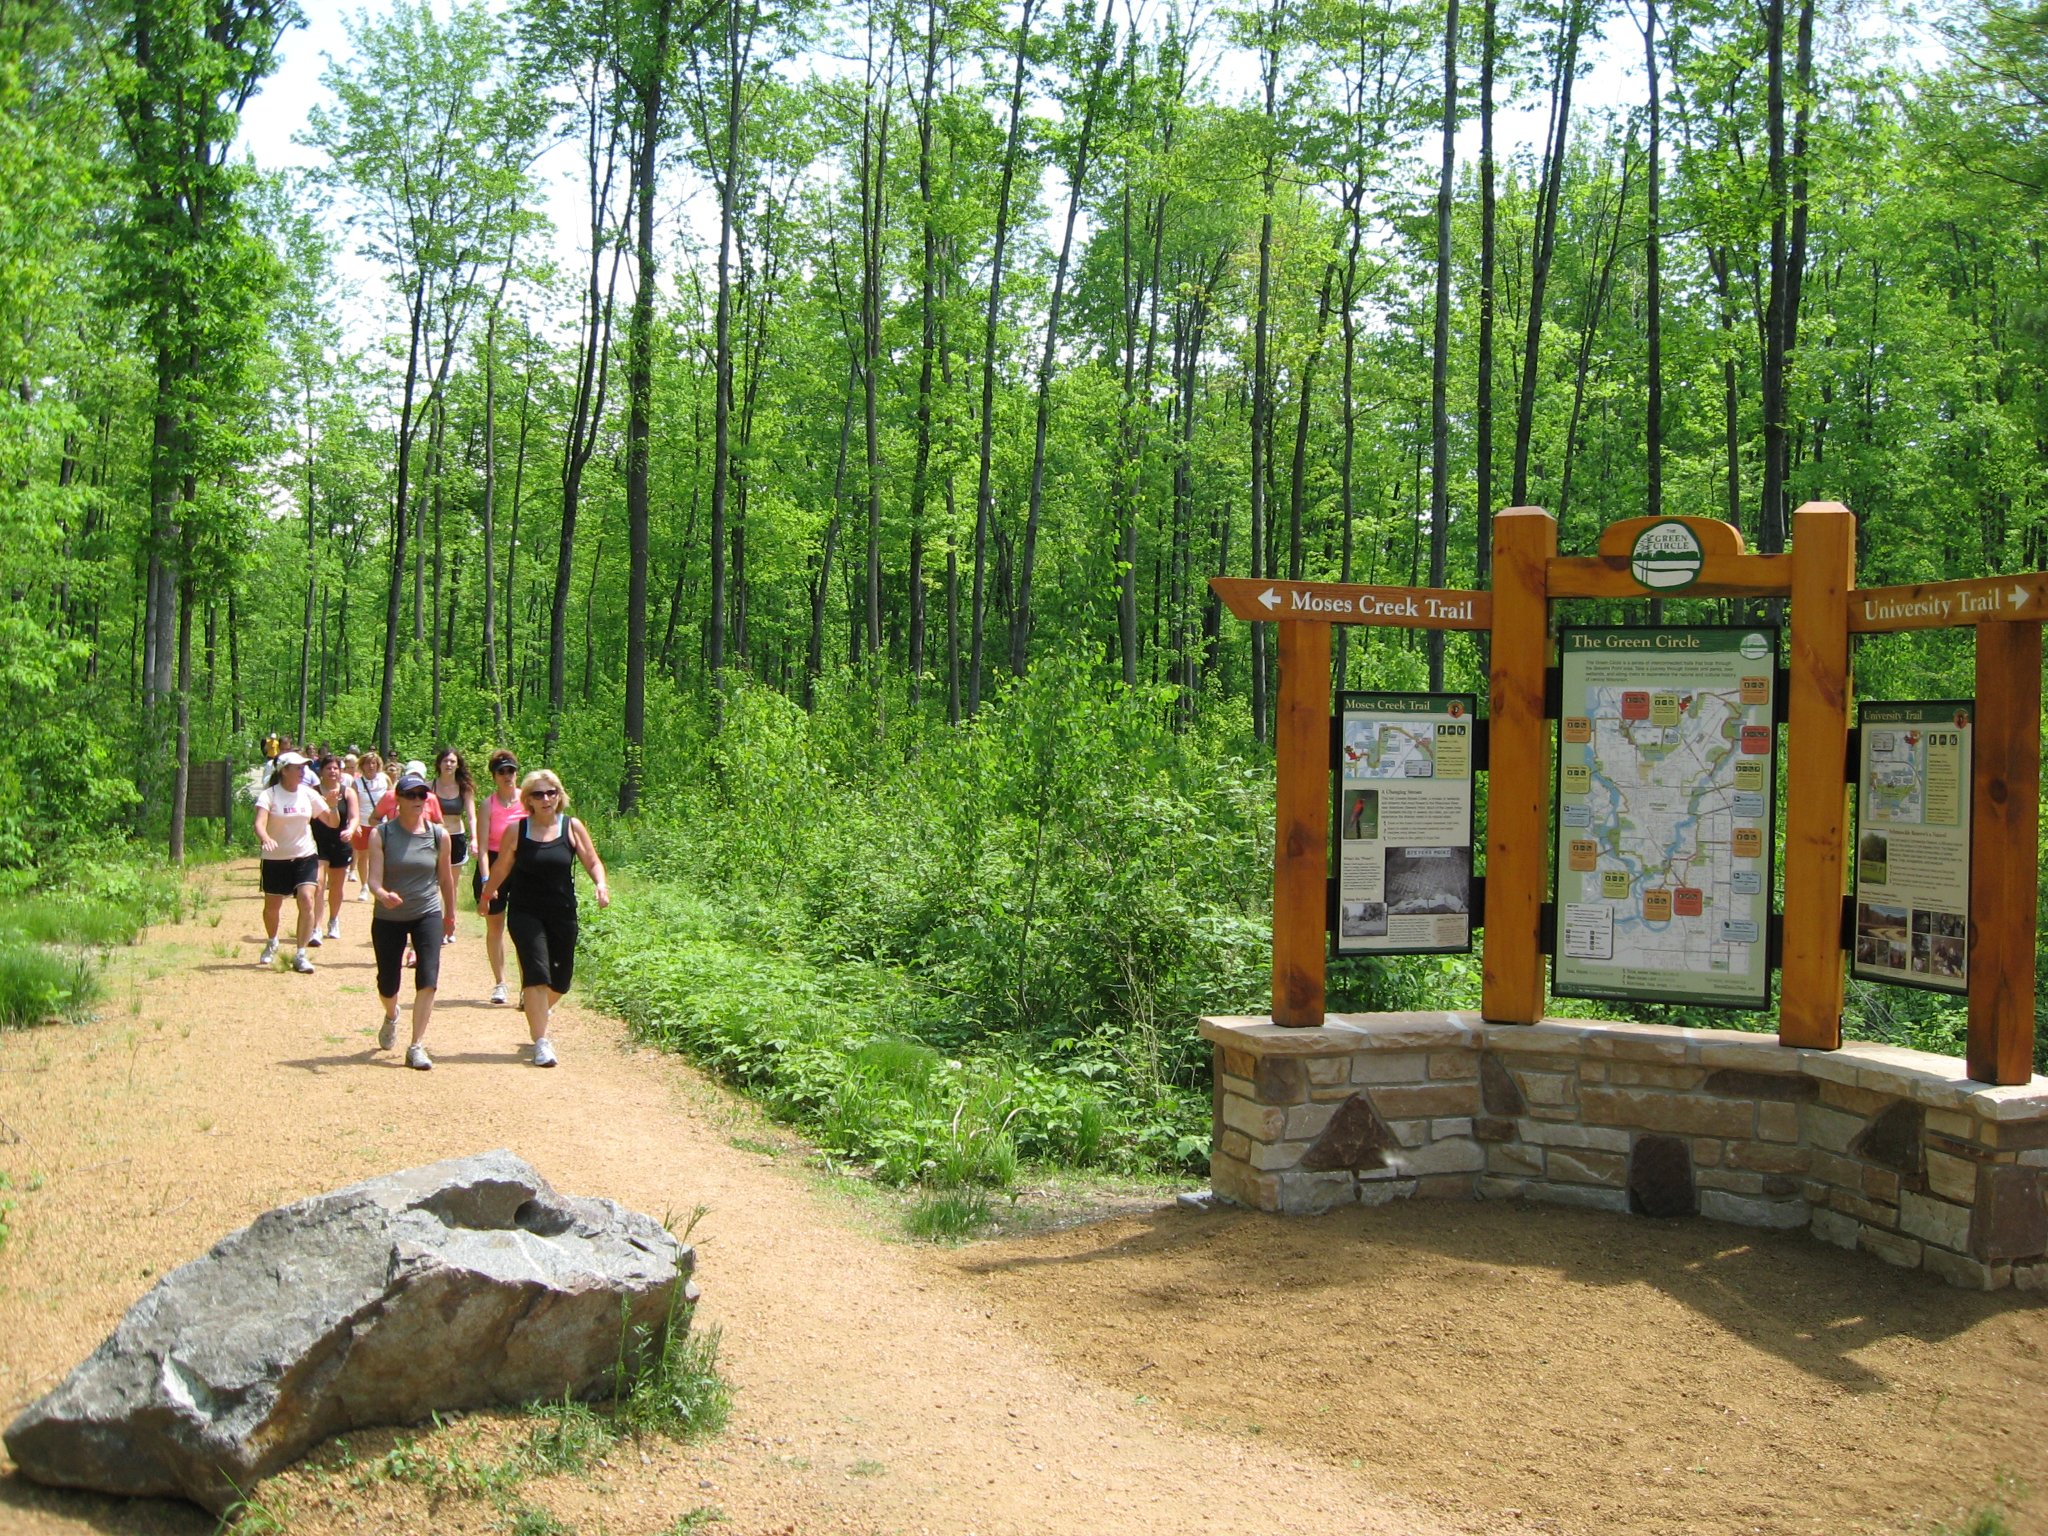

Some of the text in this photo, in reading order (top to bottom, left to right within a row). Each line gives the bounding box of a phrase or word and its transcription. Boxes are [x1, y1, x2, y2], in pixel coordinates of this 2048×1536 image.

[1653, 542, 1689, 550] CIRCLE
[1290, 590, 1473, 620] Moses Creek Trail
[1864, 588, 2001, 621] University Trail
[1572, 634, 1700, 648] The Green Circle
[1345, 700, 1430, 710] Moses Creek Trail
[1863, 710, 1923, 721] University Trail
